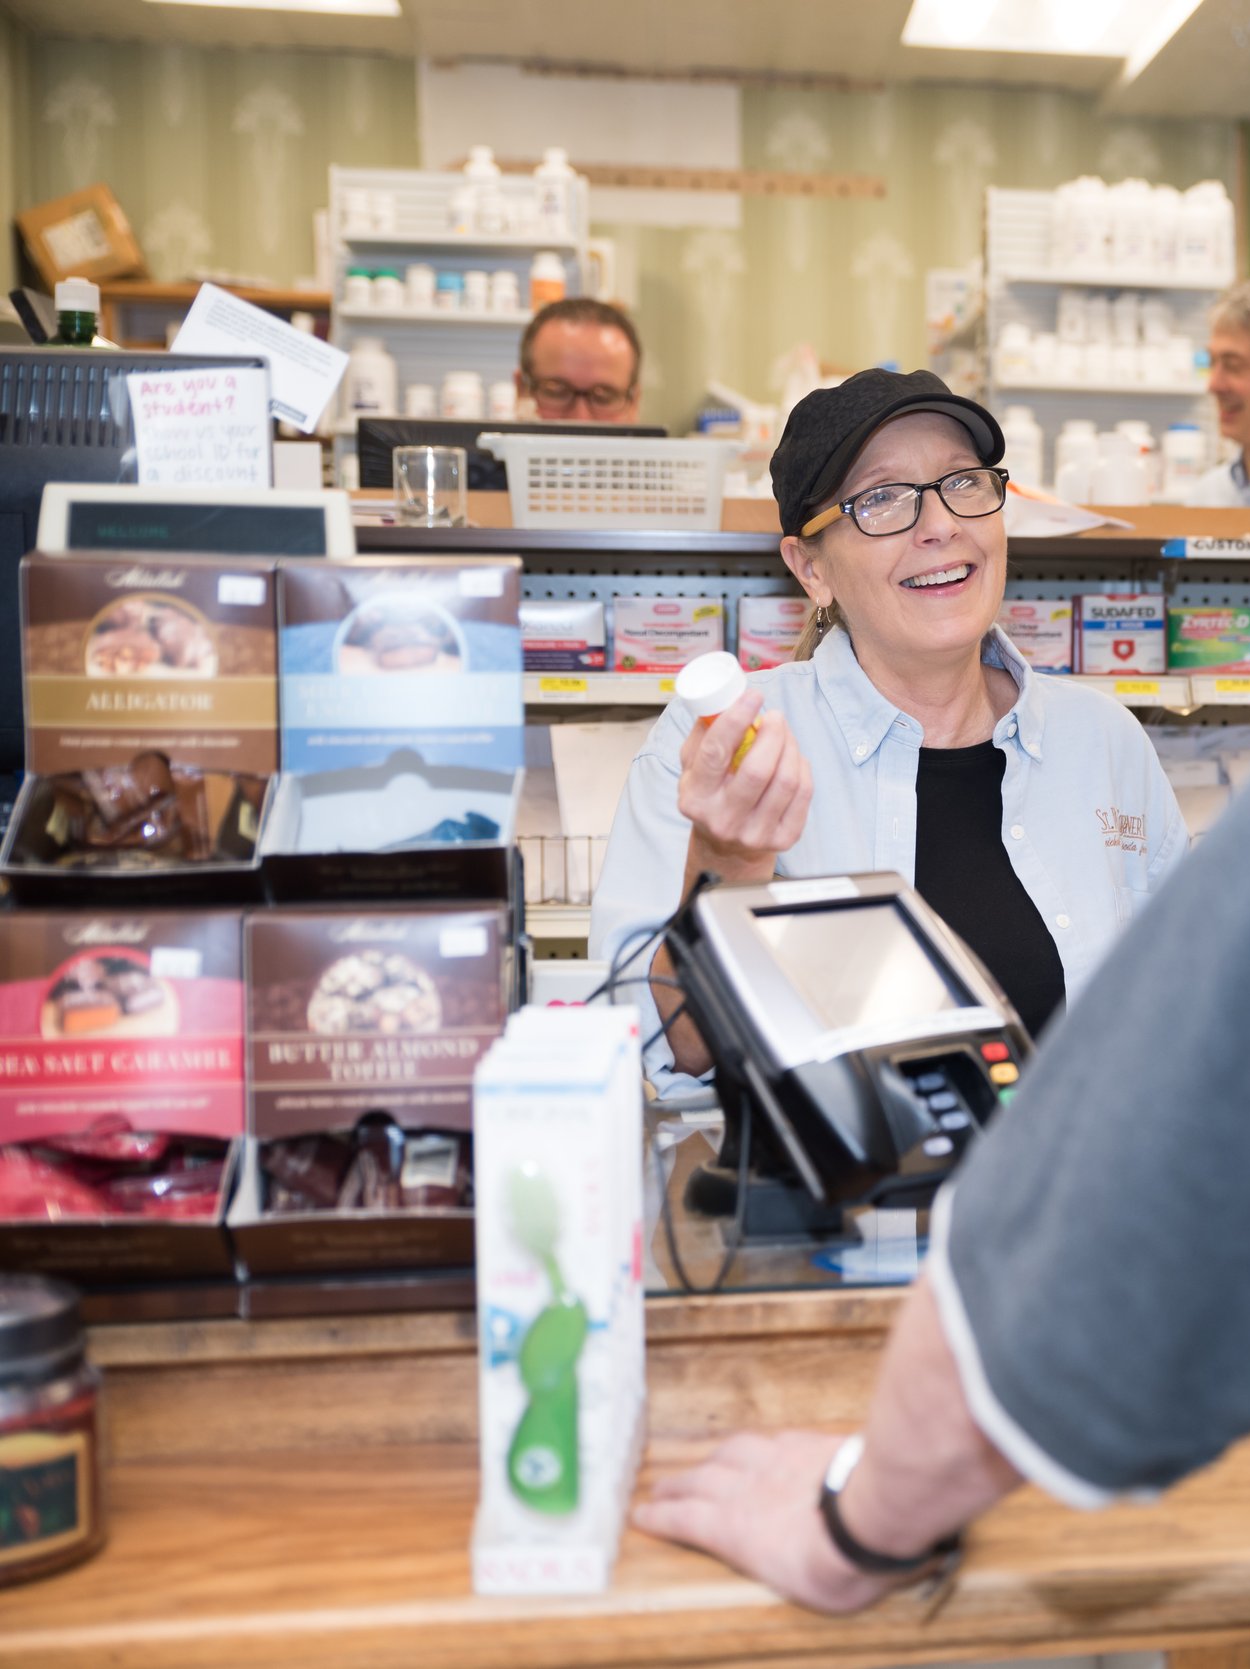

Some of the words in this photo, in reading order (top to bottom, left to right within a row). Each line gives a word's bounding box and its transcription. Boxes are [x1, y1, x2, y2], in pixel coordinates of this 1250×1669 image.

[140, 381, 176, 396] Are
[183, 377, 217, 398] you
[225, 375, 237, 389] a
[143, 395, 236, 419] student?
[174, 464, 258, 483] discount
[1091, 605, 1157, 620] SUDAFED
[624, 628, 648, 637] Nasal
[648, 628, 710, 640] Decongestant
[86, 691, 215, 712] ALLIGATOR
[268, 1040, 366, 1065] BUTTER
[371, 1037, 480, 1062] ALMOND
[42, 1050, 106, 1077] SALT
[110, 1047, 233, 1073] CARAMEL
[328, 1061, 417, 1082] TOFFEE
